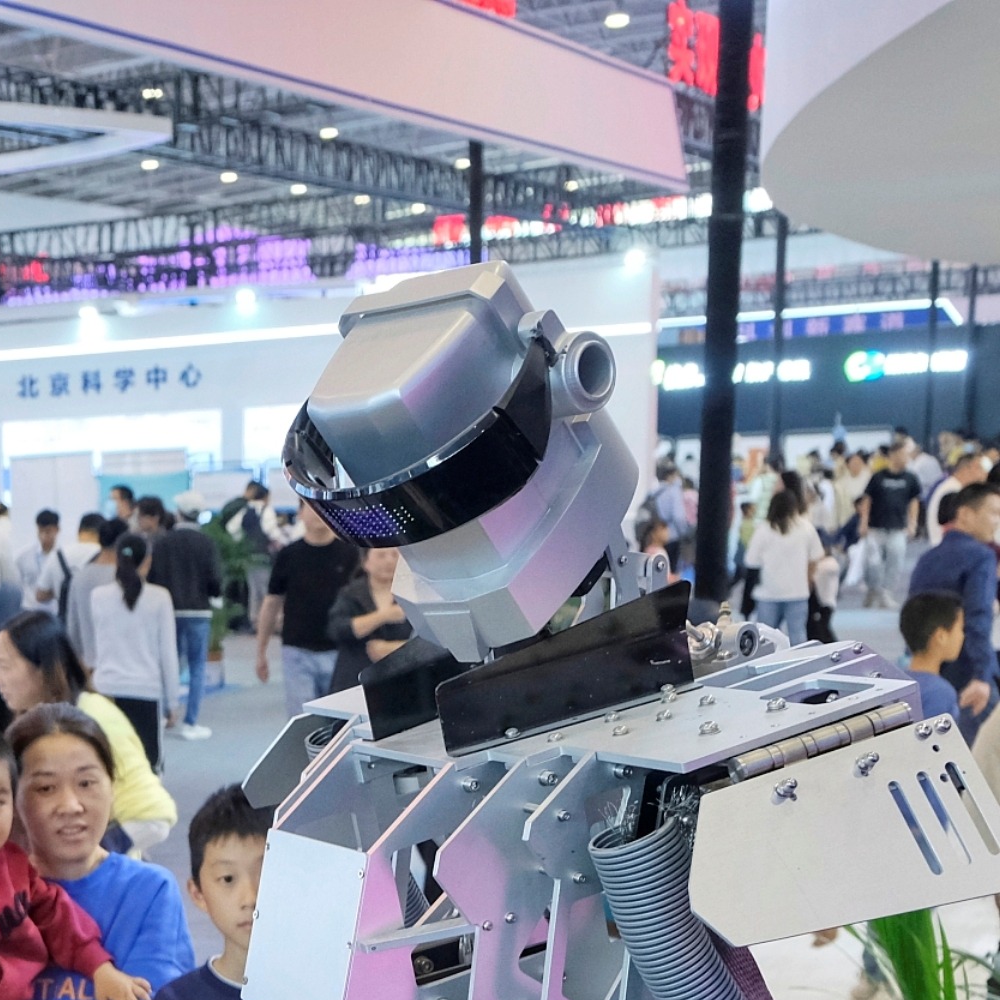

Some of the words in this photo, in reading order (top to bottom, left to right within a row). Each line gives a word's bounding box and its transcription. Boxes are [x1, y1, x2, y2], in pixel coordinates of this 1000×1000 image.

[17, 362, 202, 399] 北京科学中心
